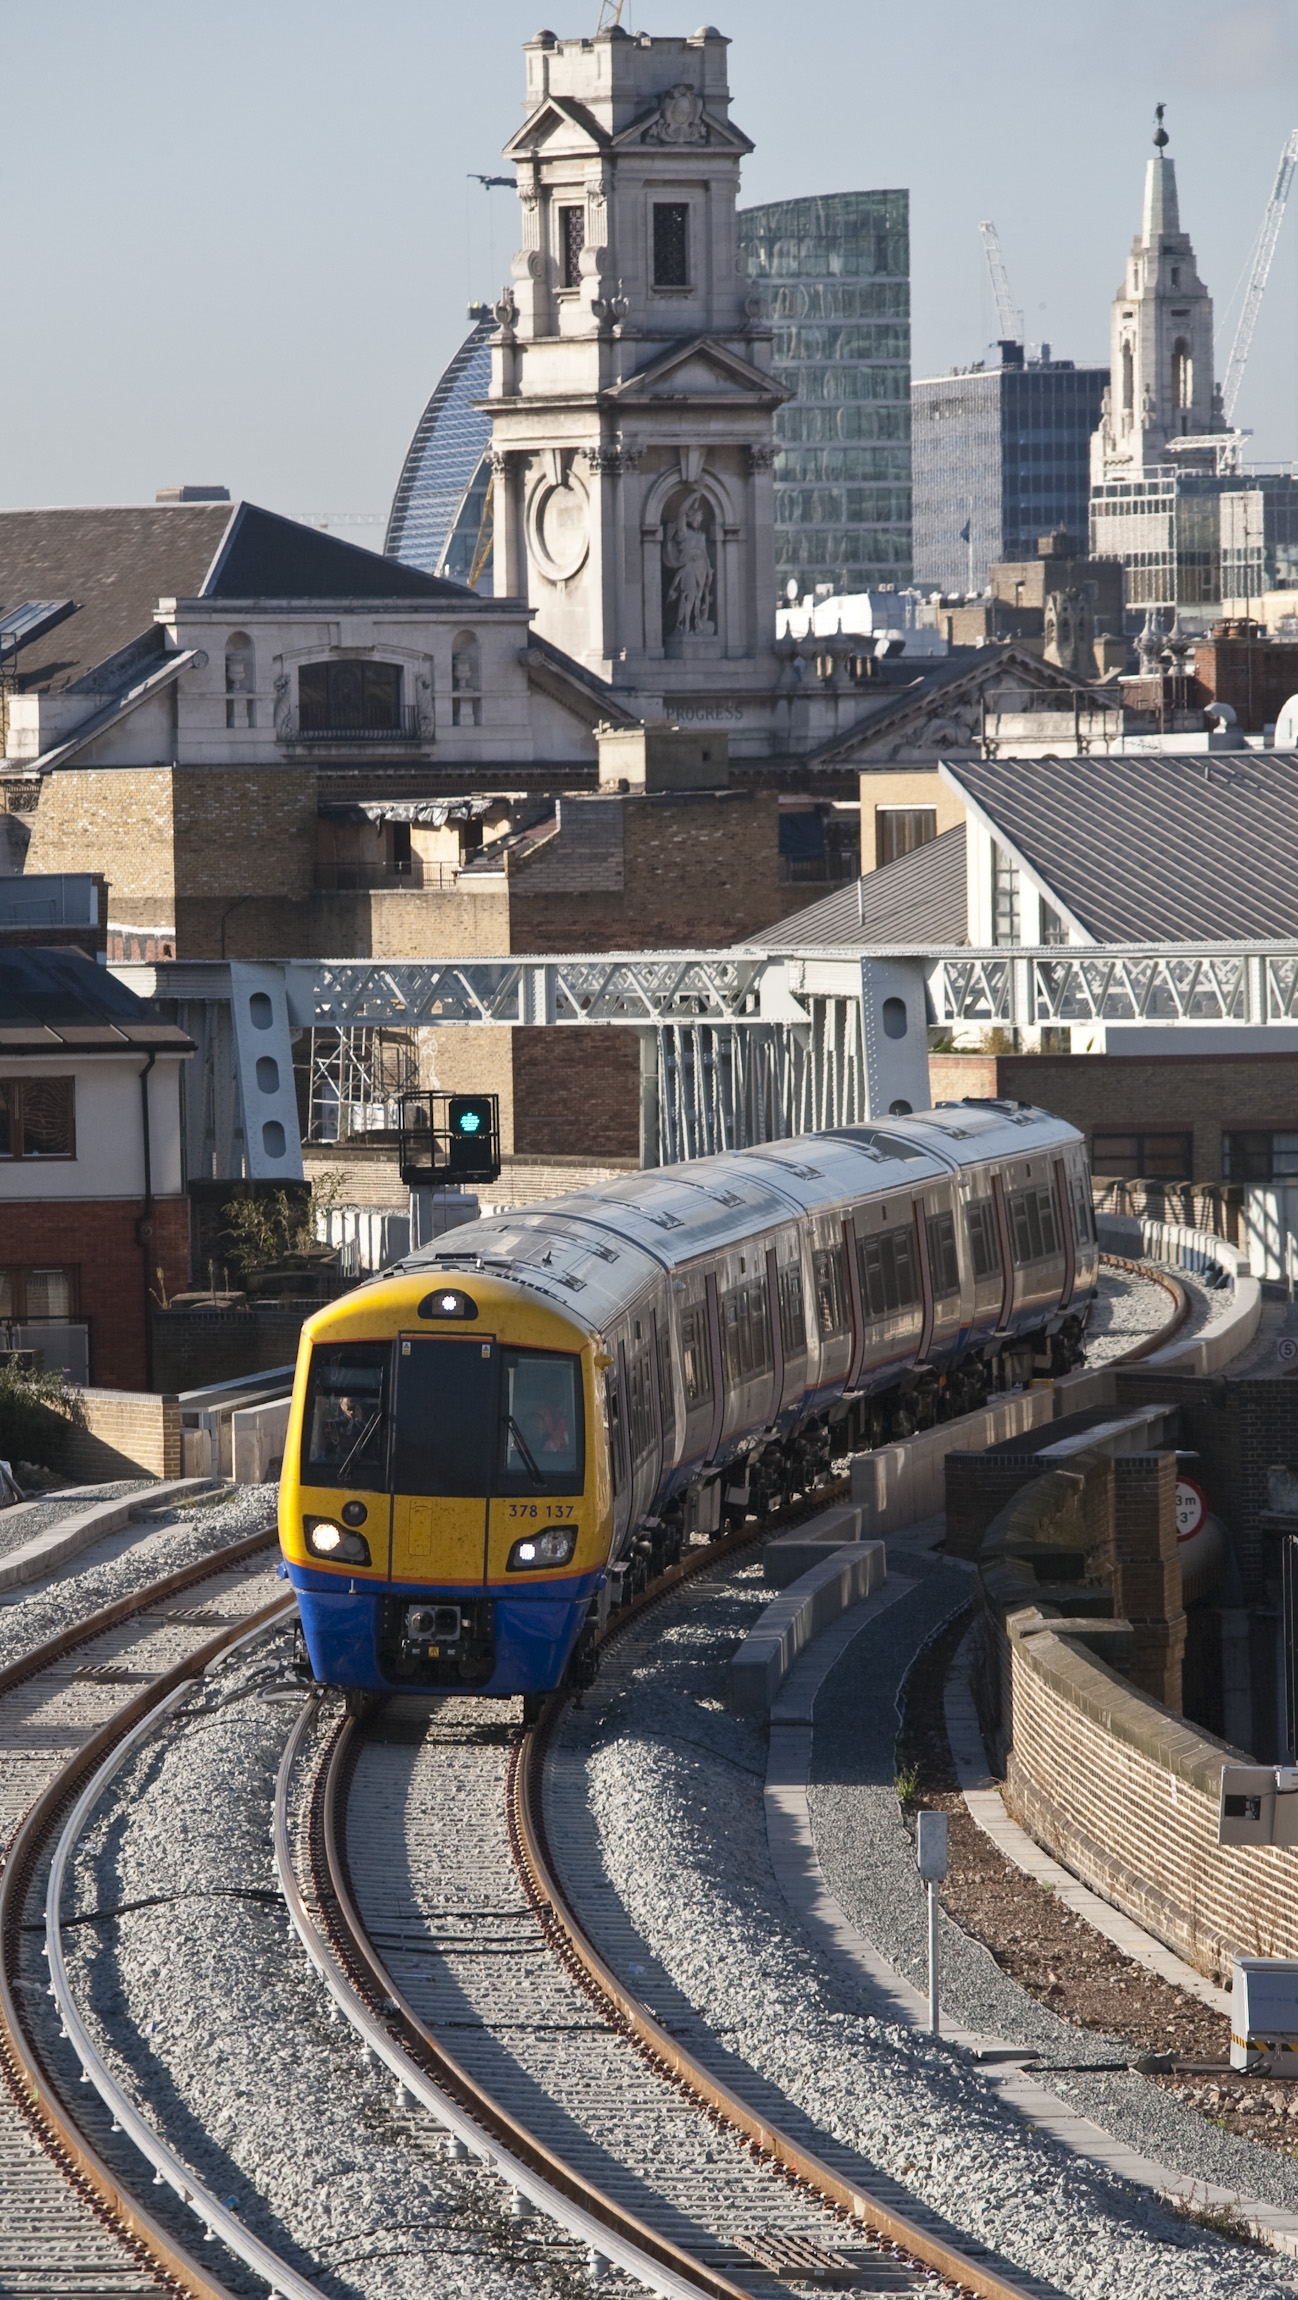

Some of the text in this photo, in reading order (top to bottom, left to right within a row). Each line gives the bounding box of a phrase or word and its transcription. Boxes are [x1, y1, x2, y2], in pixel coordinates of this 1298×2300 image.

[666, 704, 743, 720] PROGRESS
[1284, 1344, 1292, 1355] 5
[1185, 1497, 1196, 1505] m
[509, 1504, 574, 1518] 378 137
